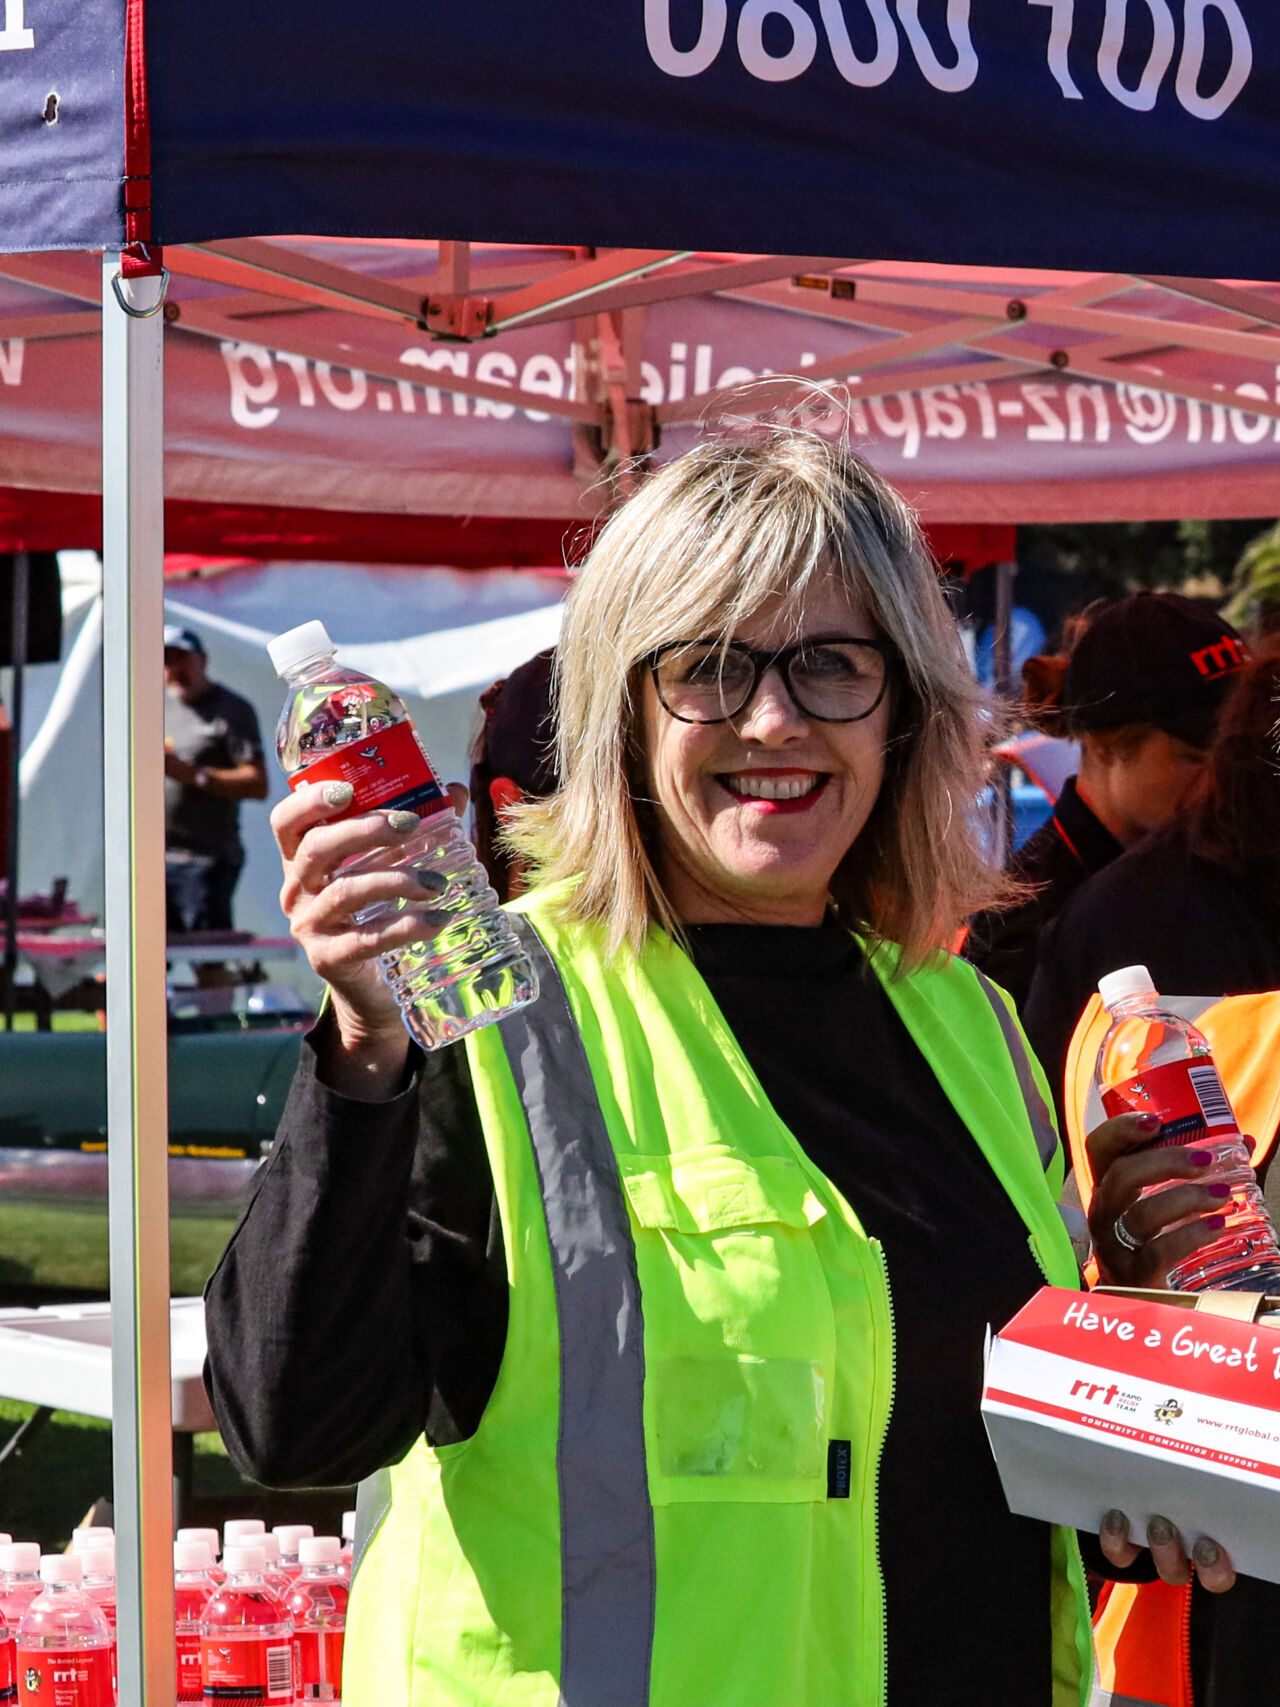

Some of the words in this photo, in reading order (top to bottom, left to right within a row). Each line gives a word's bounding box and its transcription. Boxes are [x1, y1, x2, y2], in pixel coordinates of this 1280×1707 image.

[644, 0, 979, 92] 0800
[1028, 0, 1253, 120] 100
[1063, 1301, 1135, 1341] Have
[1144, 1329, 1161, 1347] a
[1171, 1325, 1258, 1372] Great
[1070, 1378, 1119, 1405] rrt
[1121, 1392, 1142, 1402] RAPID
[1116, 1403, 1137, 1413] TEAM
[1118, 1398, 1140, 1407] RELIEF
[1081, 1415, 1138, 1437] COMMUNITY
[1148, 1434, 1207, 1456] COMPASSION
[1218, 1453, 1259, 1469] SUPPORT
[53, 1668, 77, 1683] rrt
